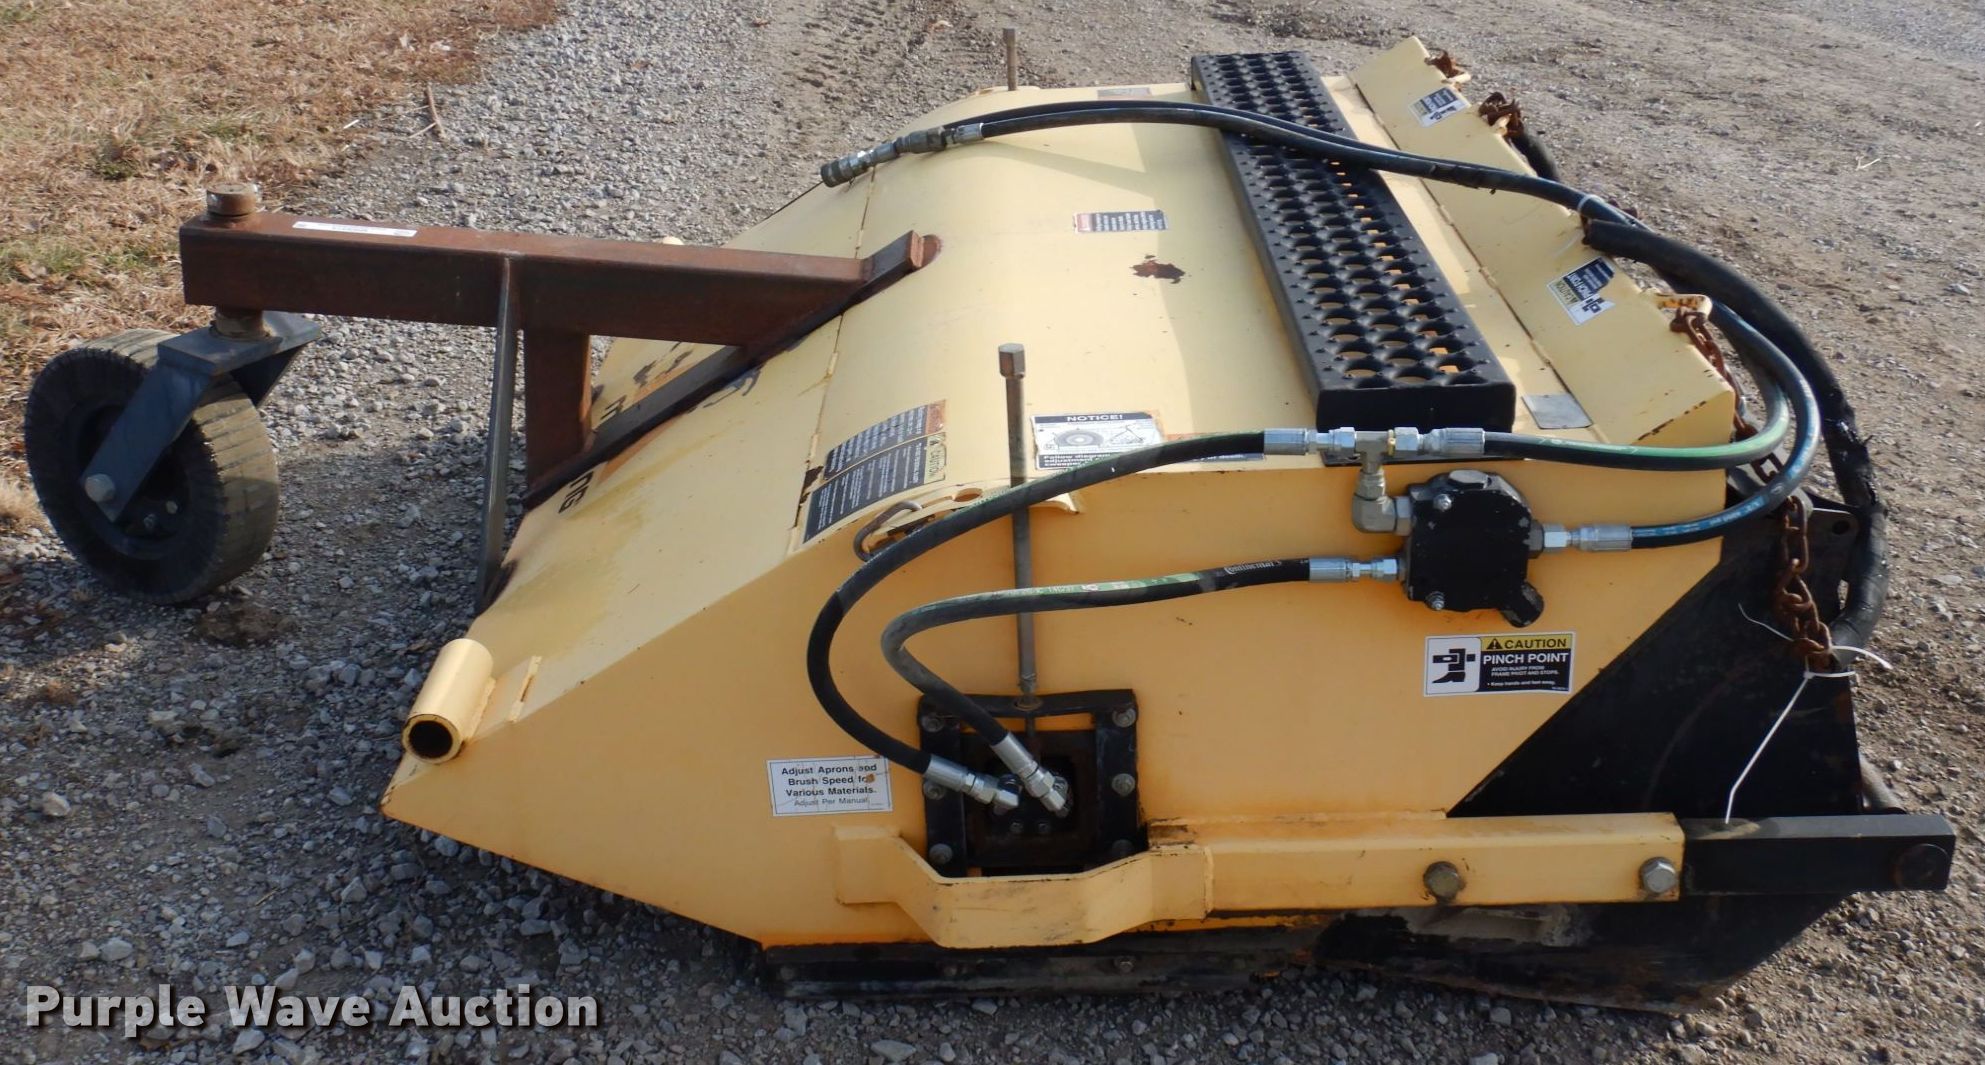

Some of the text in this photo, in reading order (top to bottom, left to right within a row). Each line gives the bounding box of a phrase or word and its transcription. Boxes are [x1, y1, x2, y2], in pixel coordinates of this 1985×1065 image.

[1067, 414, 1123, 422] NOTICE!
[1504, 638, 1566, 649] CAUTION
[1483, 653, 1568, 664] PINCH POINT
[781, 764, 877, 776] Adjust Aprons and
[788, 777, 818, 786] Brush
[822, 776, 854, 786] Speed
[785, 787, 824, 797] Various
[794, 800, 819, 808] Adjust
